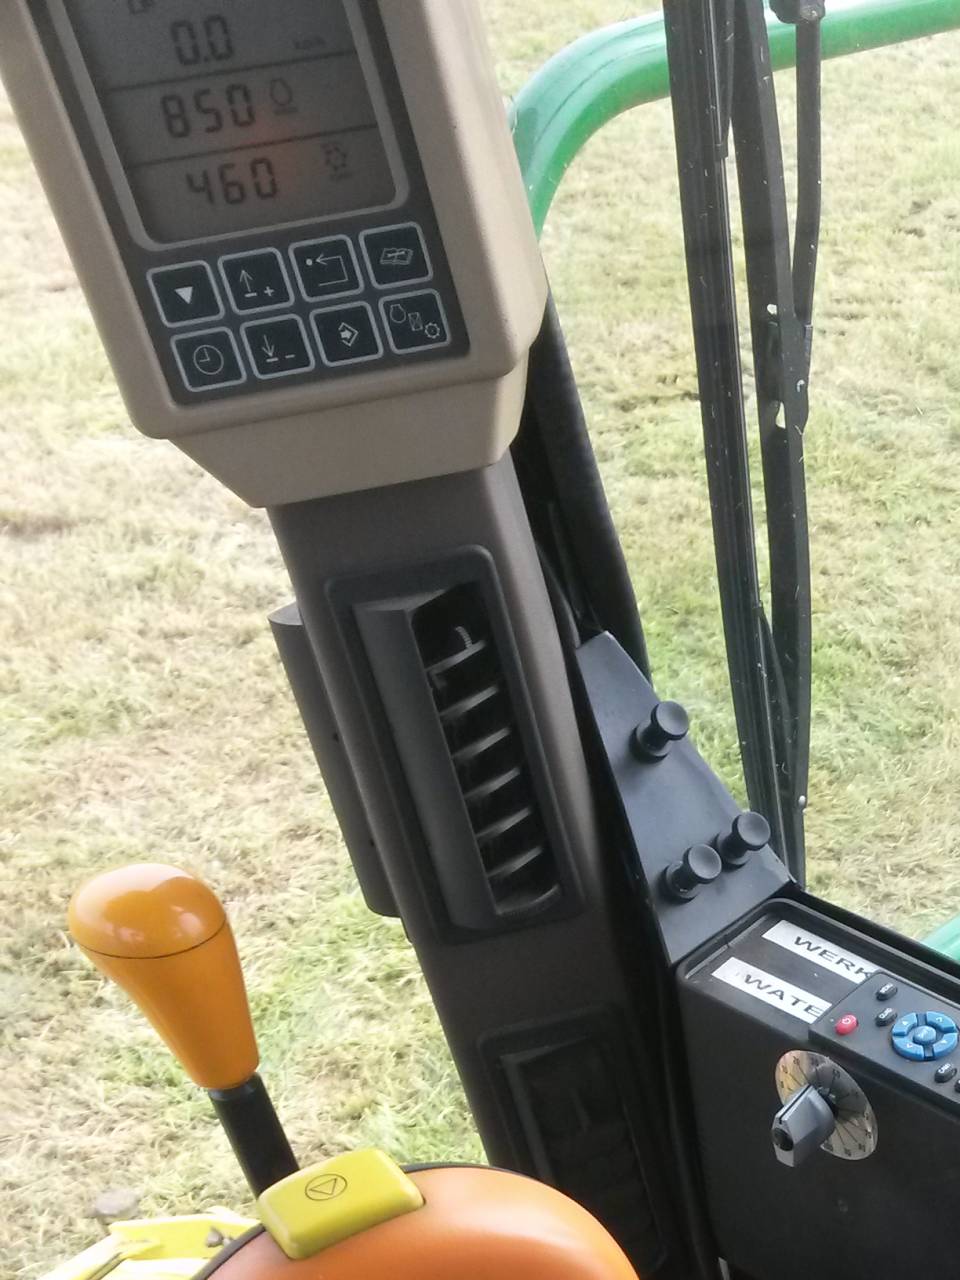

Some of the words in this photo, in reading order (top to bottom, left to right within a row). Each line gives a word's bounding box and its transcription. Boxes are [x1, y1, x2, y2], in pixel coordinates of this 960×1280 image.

[170, 14, 233, 65] 0.0
[160, 84, 255, 138] 850
[185, 157, 279, 204] 460
[744, 974, 825, 1018] WATE
